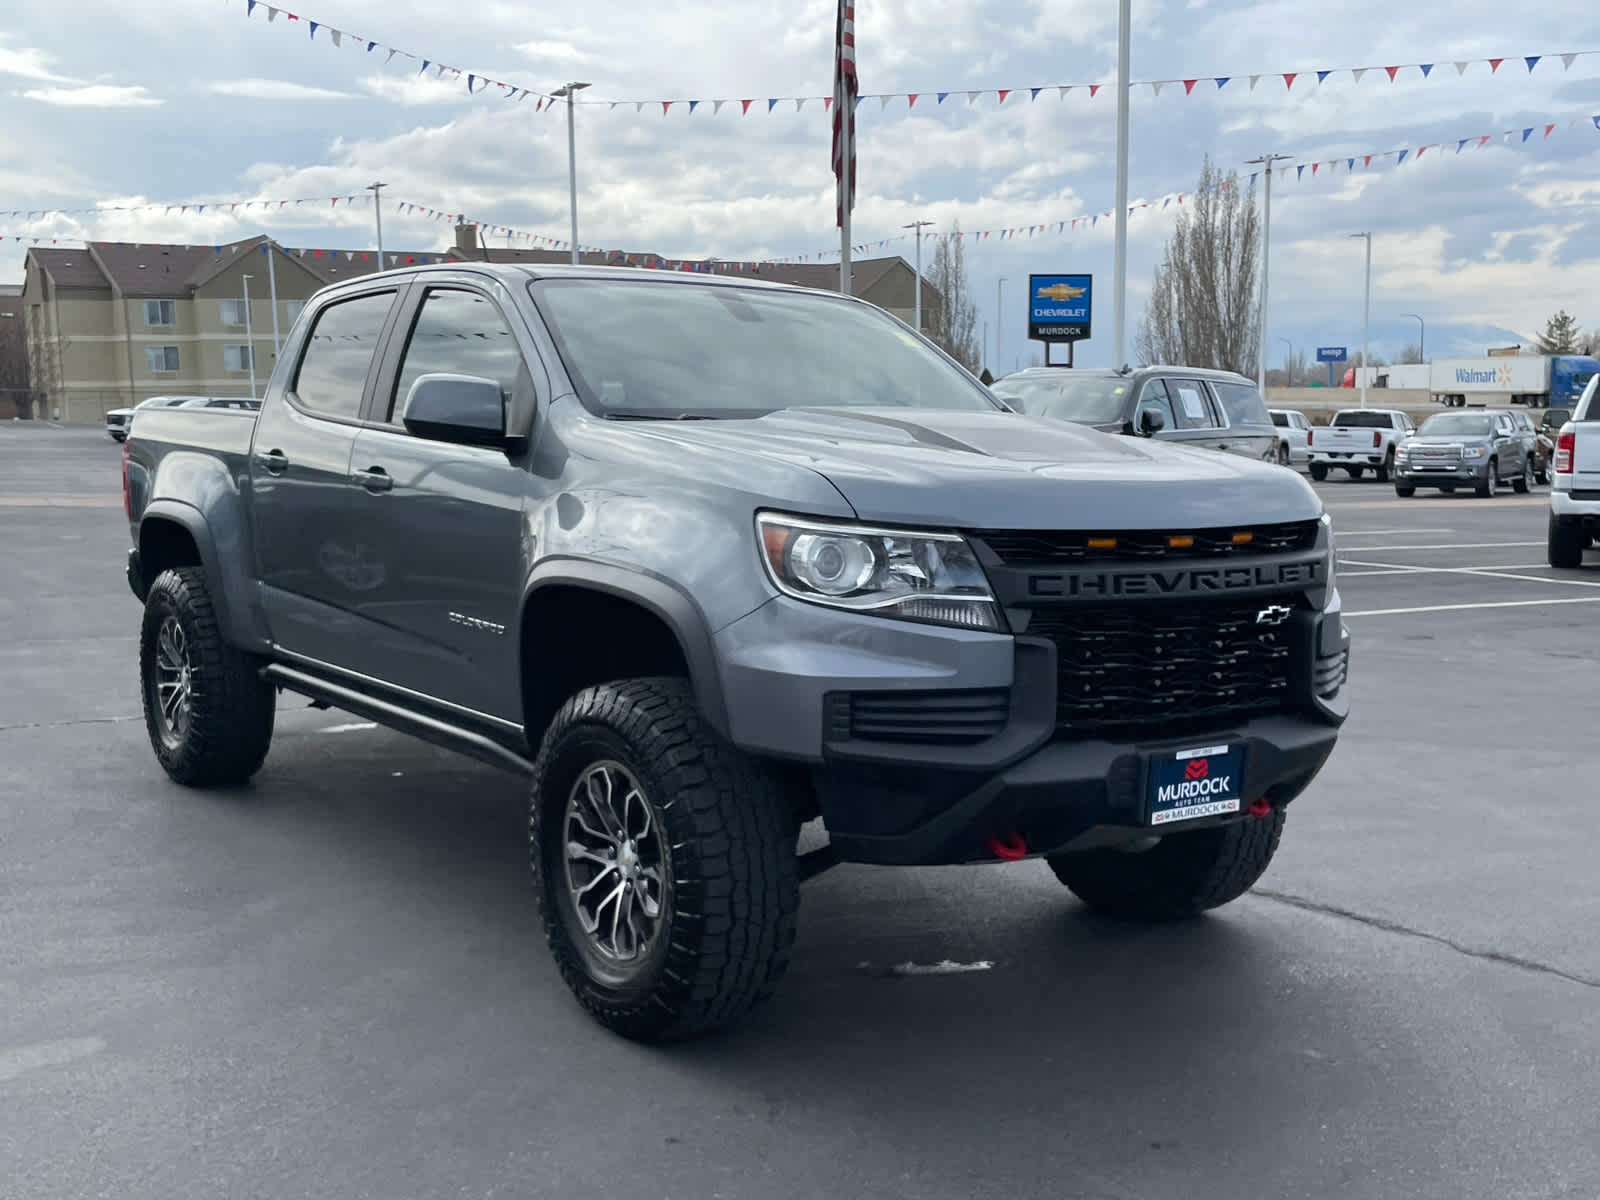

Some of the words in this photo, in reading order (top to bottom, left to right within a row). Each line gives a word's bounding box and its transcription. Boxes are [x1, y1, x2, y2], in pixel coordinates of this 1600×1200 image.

[1034, 308, 1087, 317] CHEVROLET
[1038, 327, 1081, 335] MURDOCK
[1455, 367, 1497, 384] Walmart
[1028, 561, 1322, 597] CHEVROLET
[1158, 775, 1230, 803] MURDOCK
[1171, 803, 1220, 819] MURDOCK
